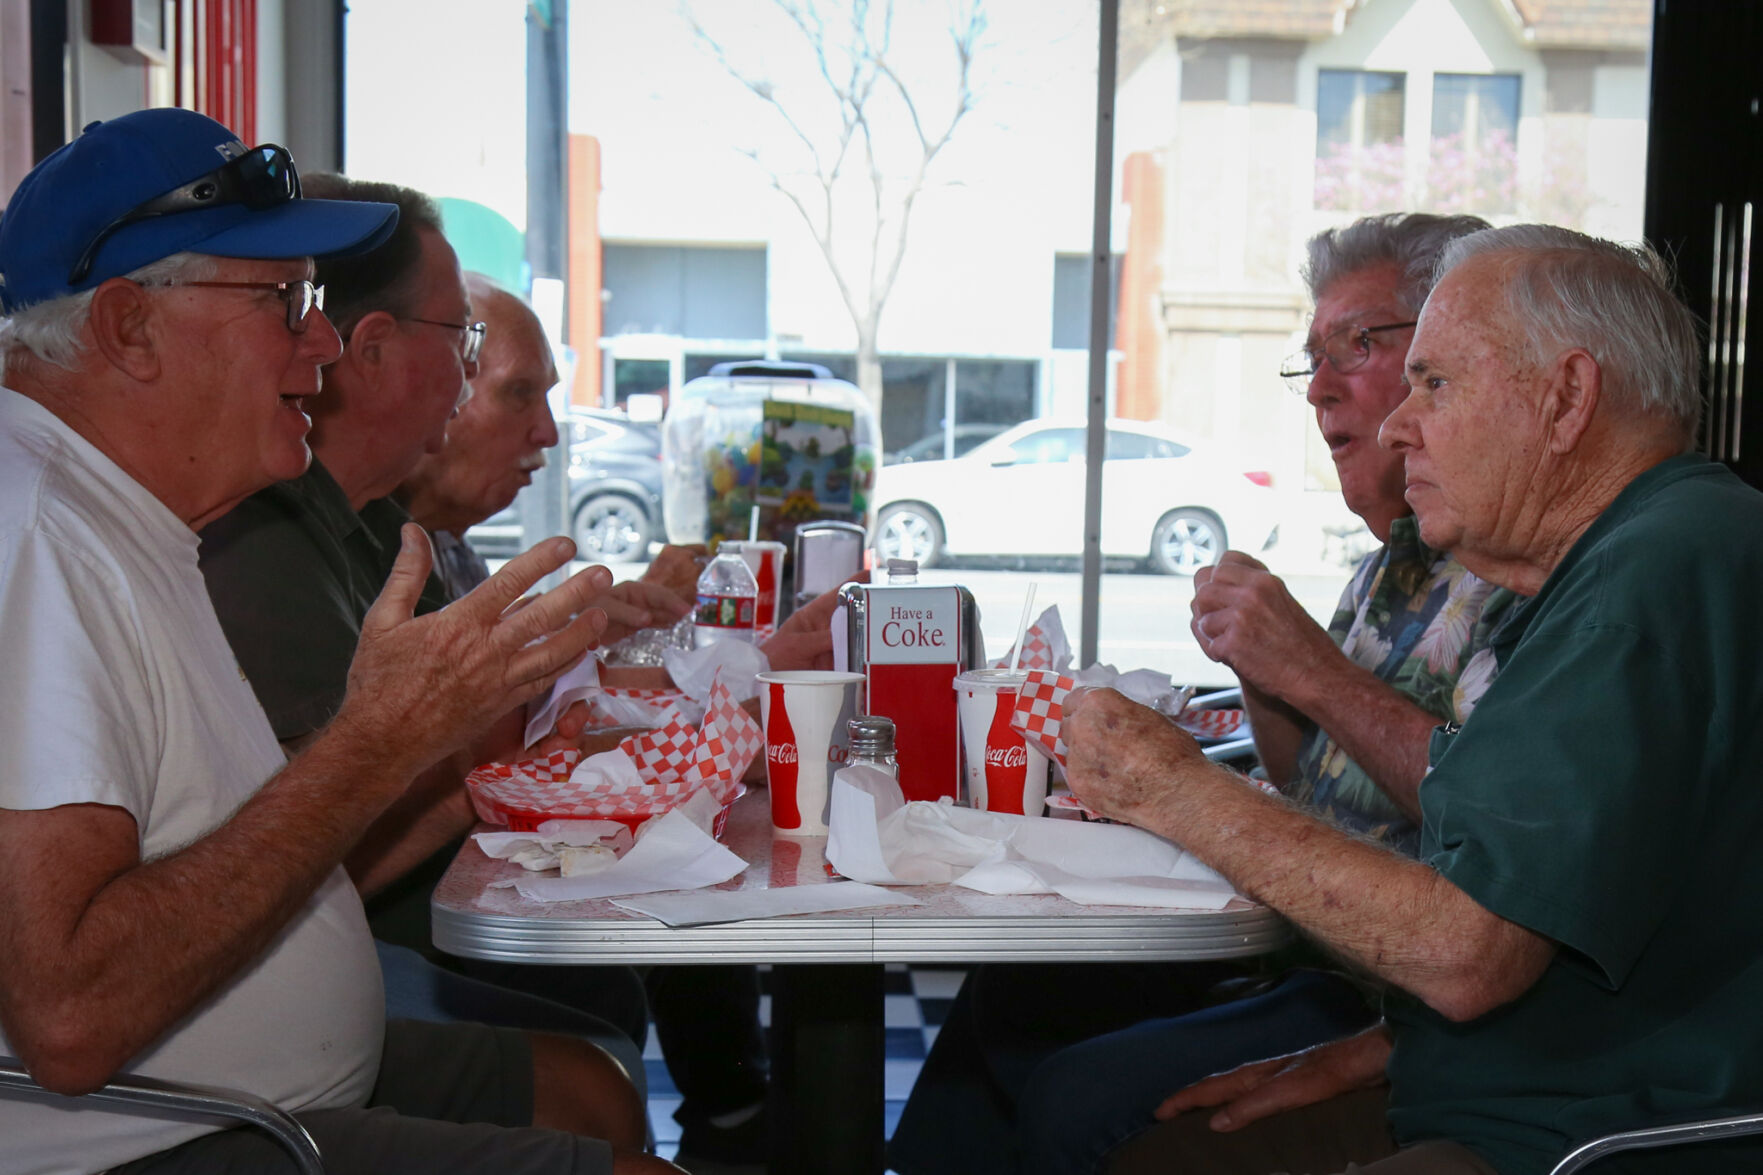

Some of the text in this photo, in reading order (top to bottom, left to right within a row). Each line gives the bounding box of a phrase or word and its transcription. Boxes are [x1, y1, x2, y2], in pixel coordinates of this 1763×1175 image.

[890, 606, 933, 620] Have a
[881, 621, 944, 647] Coke
